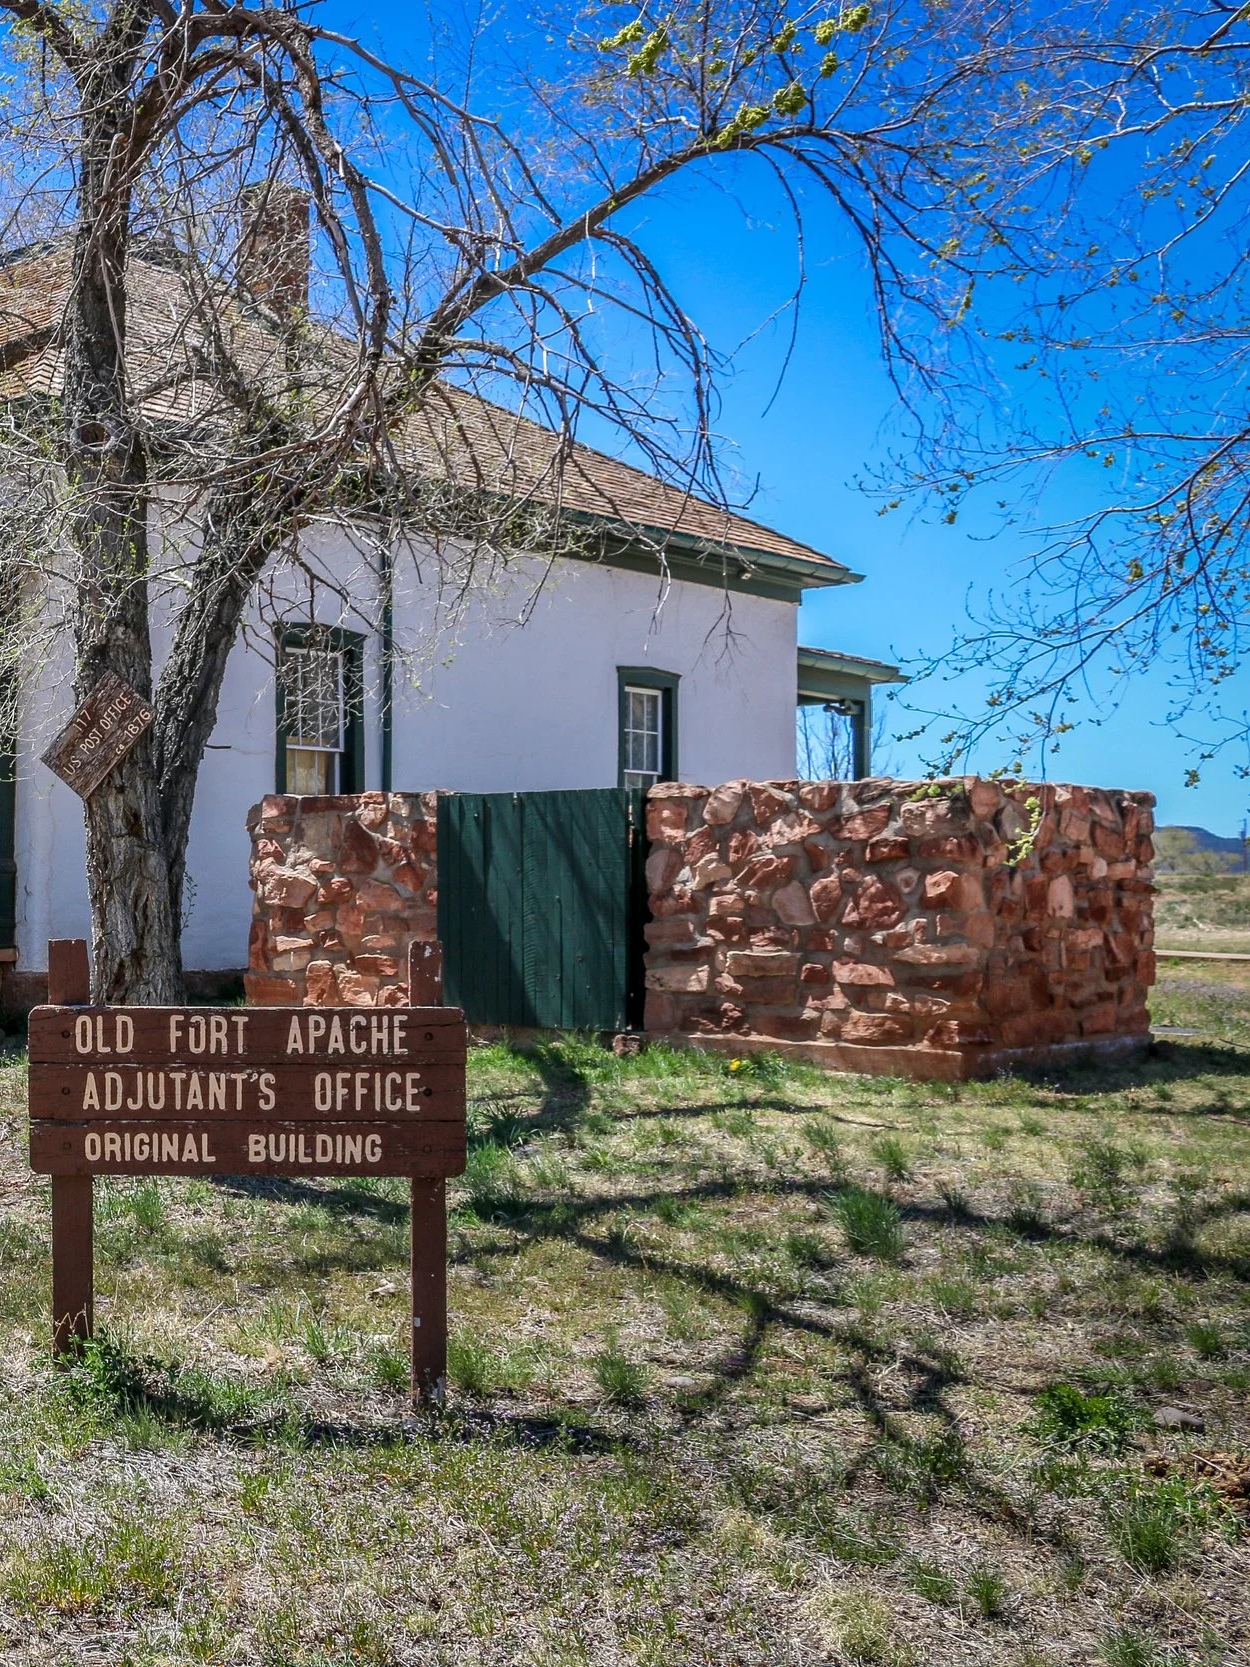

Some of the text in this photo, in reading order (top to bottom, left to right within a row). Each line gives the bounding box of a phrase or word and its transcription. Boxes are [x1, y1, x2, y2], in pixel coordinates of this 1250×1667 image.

[63, 691, 132, 775] US POST OFFICE
[72, 709, 91, 732] 117
[124, 708, 151, 739] 1876
[75, 1014, 409, 1055] OLD FORT APACHE
[82, 1071, 421, 1112] ADJUTANT'S OFFICE
[84, 1132, 383, 1164] ORIGINAL BUILDING
